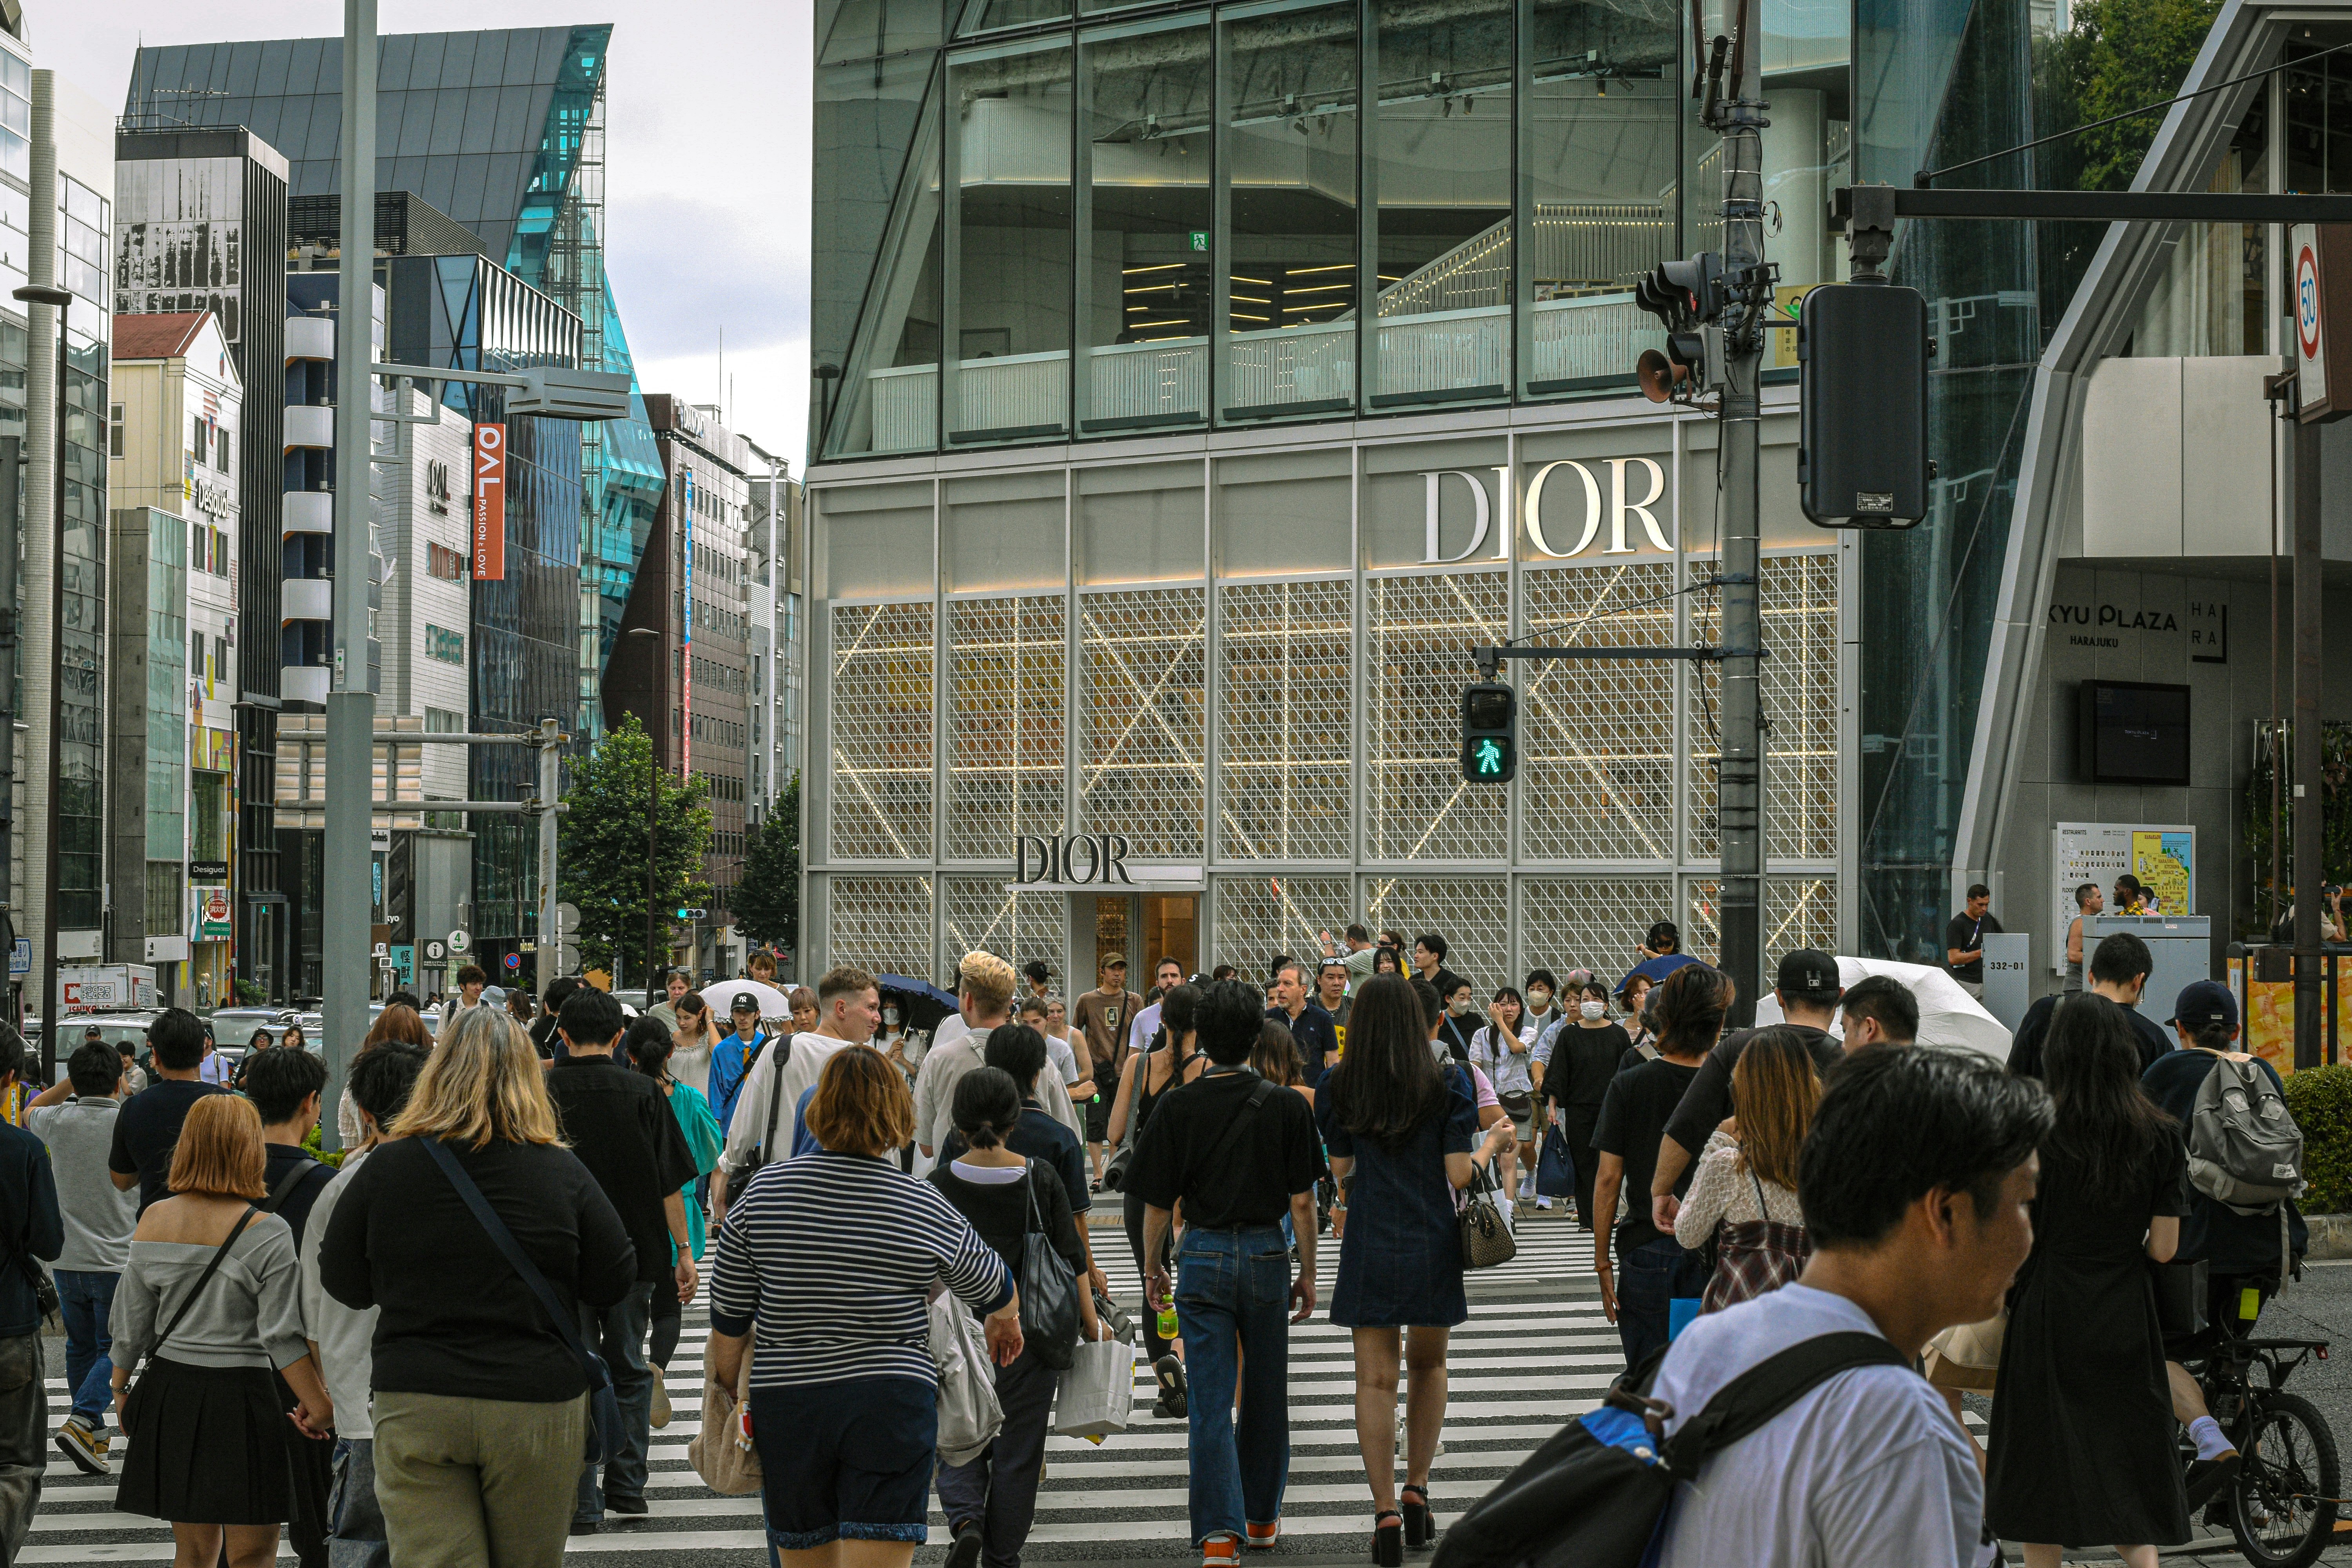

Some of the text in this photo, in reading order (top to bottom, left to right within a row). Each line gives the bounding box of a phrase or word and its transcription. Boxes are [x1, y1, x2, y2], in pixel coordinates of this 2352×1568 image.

[2300, 278, 2316, 328] 50
[1417, 457, 1675, 564] DIOR
[2098, 604, 2178, 632] PLAZA
[2070, 635, 2118, 648] HARAJUKU
[1014, 835, 1135, 884] DIOR
[193, 866, 226, 874] Desigual.
[454, 933, 461, 942] 4
[1991, 962, 2024, 971] 332-01
